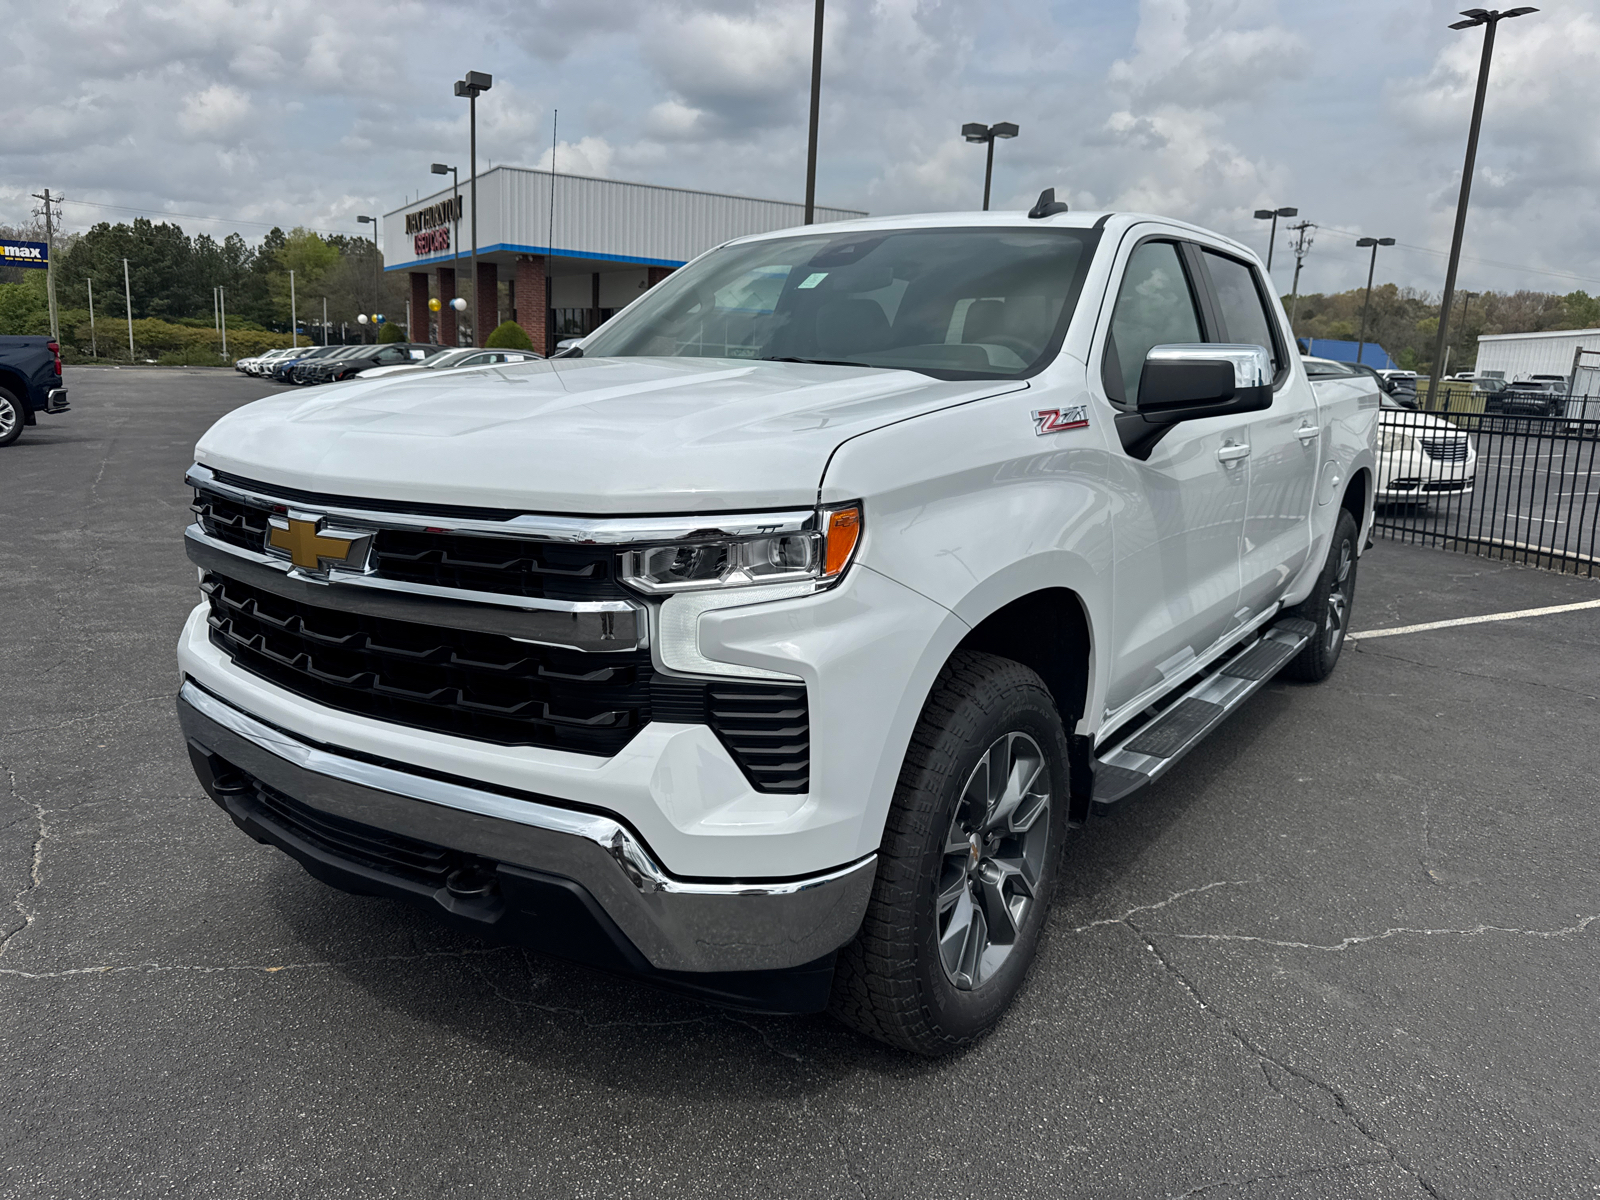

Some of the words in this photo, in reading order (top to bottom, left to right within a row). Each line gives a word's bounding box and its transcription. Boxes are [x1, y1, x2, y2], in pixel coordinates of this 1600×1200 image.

[414, 232, 431, 255] USED
[430, 227, 450, 251] CARS
[1030, 405, 1090, 436] Z71
